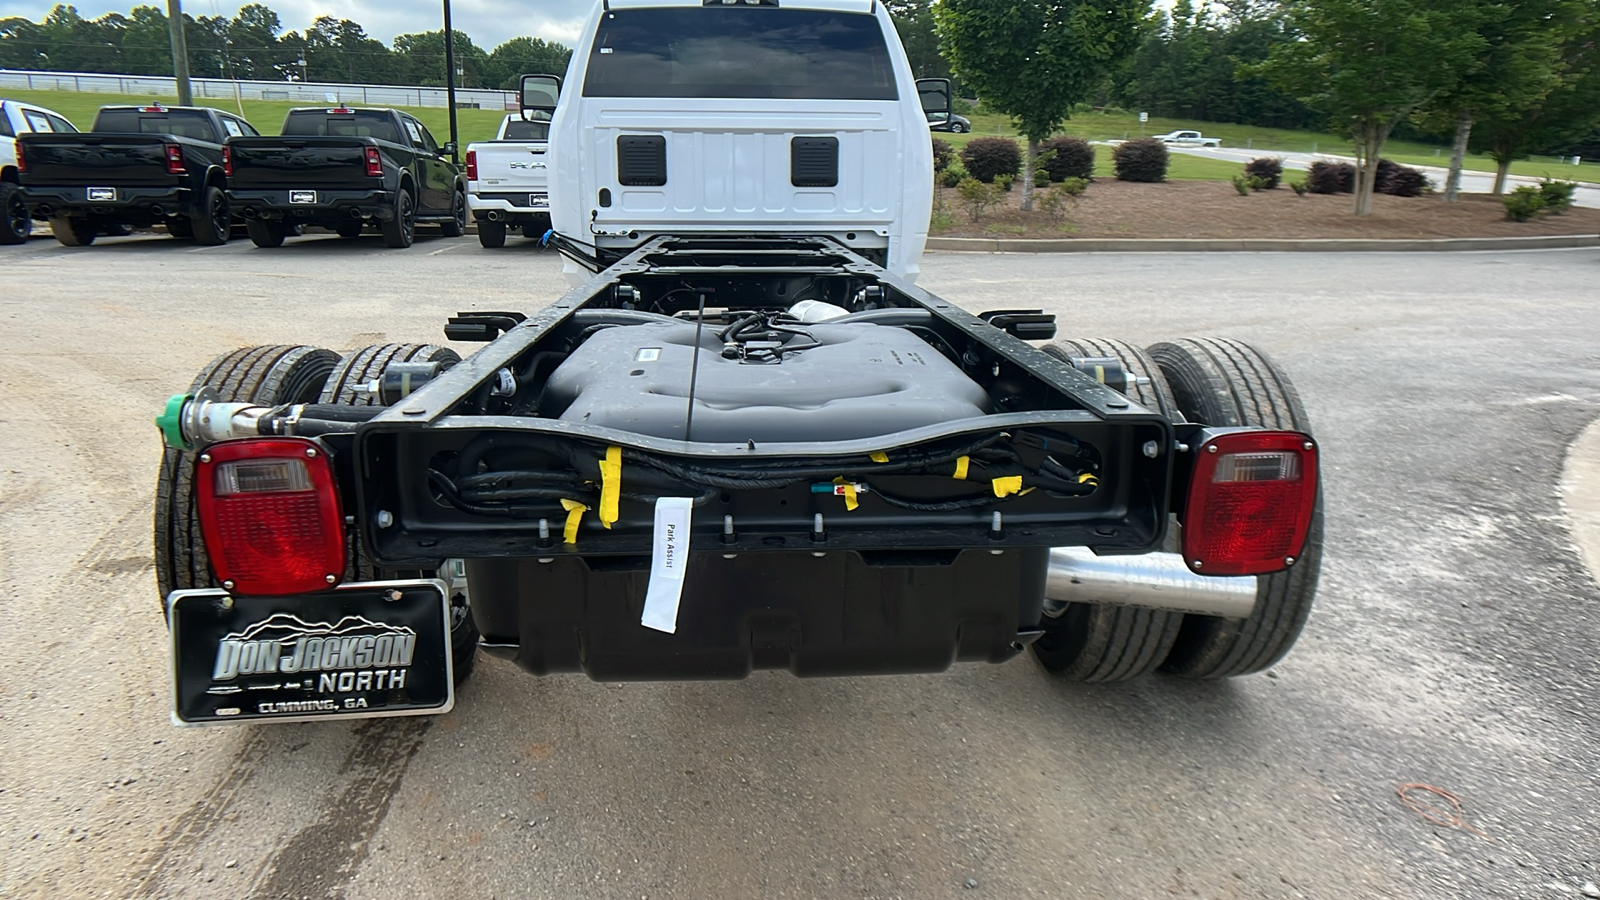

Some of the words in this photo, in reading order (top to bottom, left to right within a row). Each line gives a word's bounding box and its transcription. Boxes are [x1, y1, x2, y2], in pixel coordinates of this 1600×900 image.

[510, 161, 547, 169] RA
[667, 524, 675, 542] Park
[666, 544, 675, 568] Assist
[212, 639, 281, 680] DON
[280, 633, 416, 673] JACKSON
[319, 669, 406, 693] NORTH
[344, 697, 368, 708] GA
